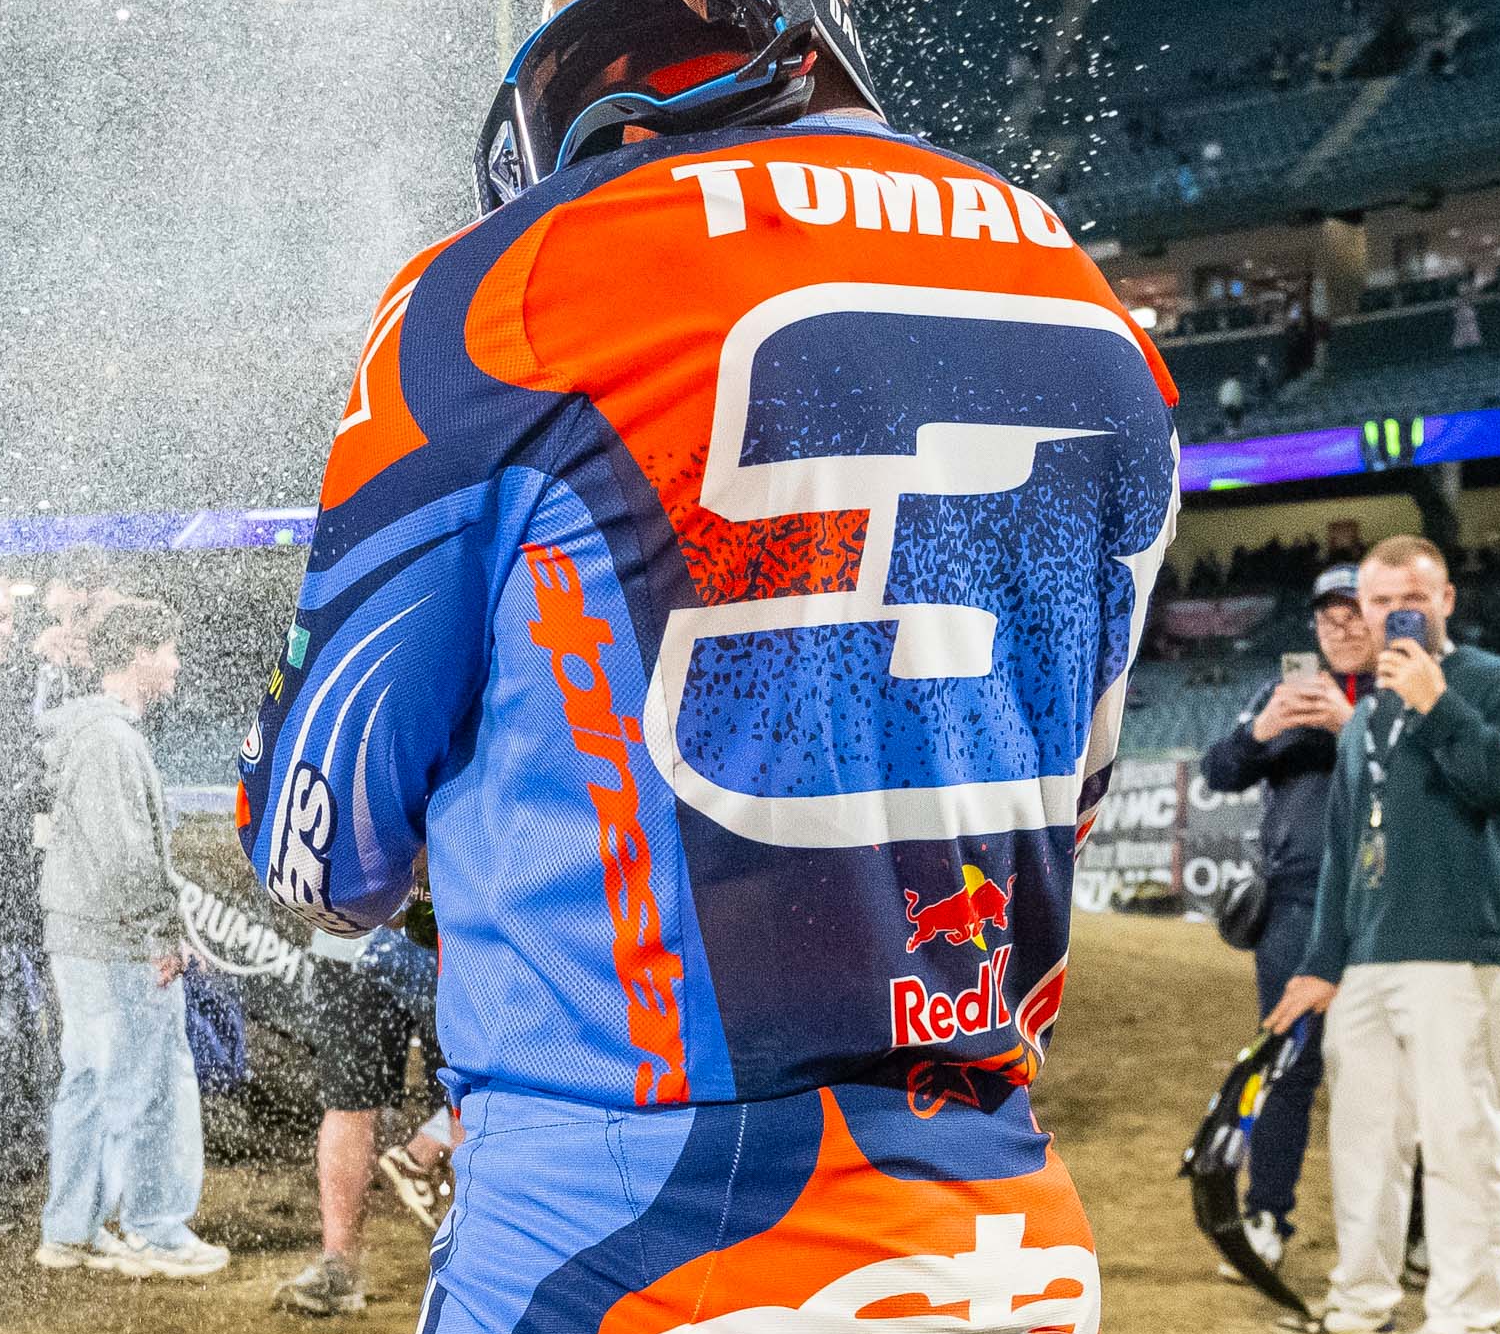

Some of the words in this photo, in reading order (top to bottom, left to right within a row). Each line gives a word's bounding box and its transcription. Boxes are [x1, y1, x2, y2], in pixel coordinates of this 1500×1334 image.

[671, 159, 1073, 249] TOMAC
[647, 280, 1180, 848] 3
[889, 960, 992, 1048] Red
